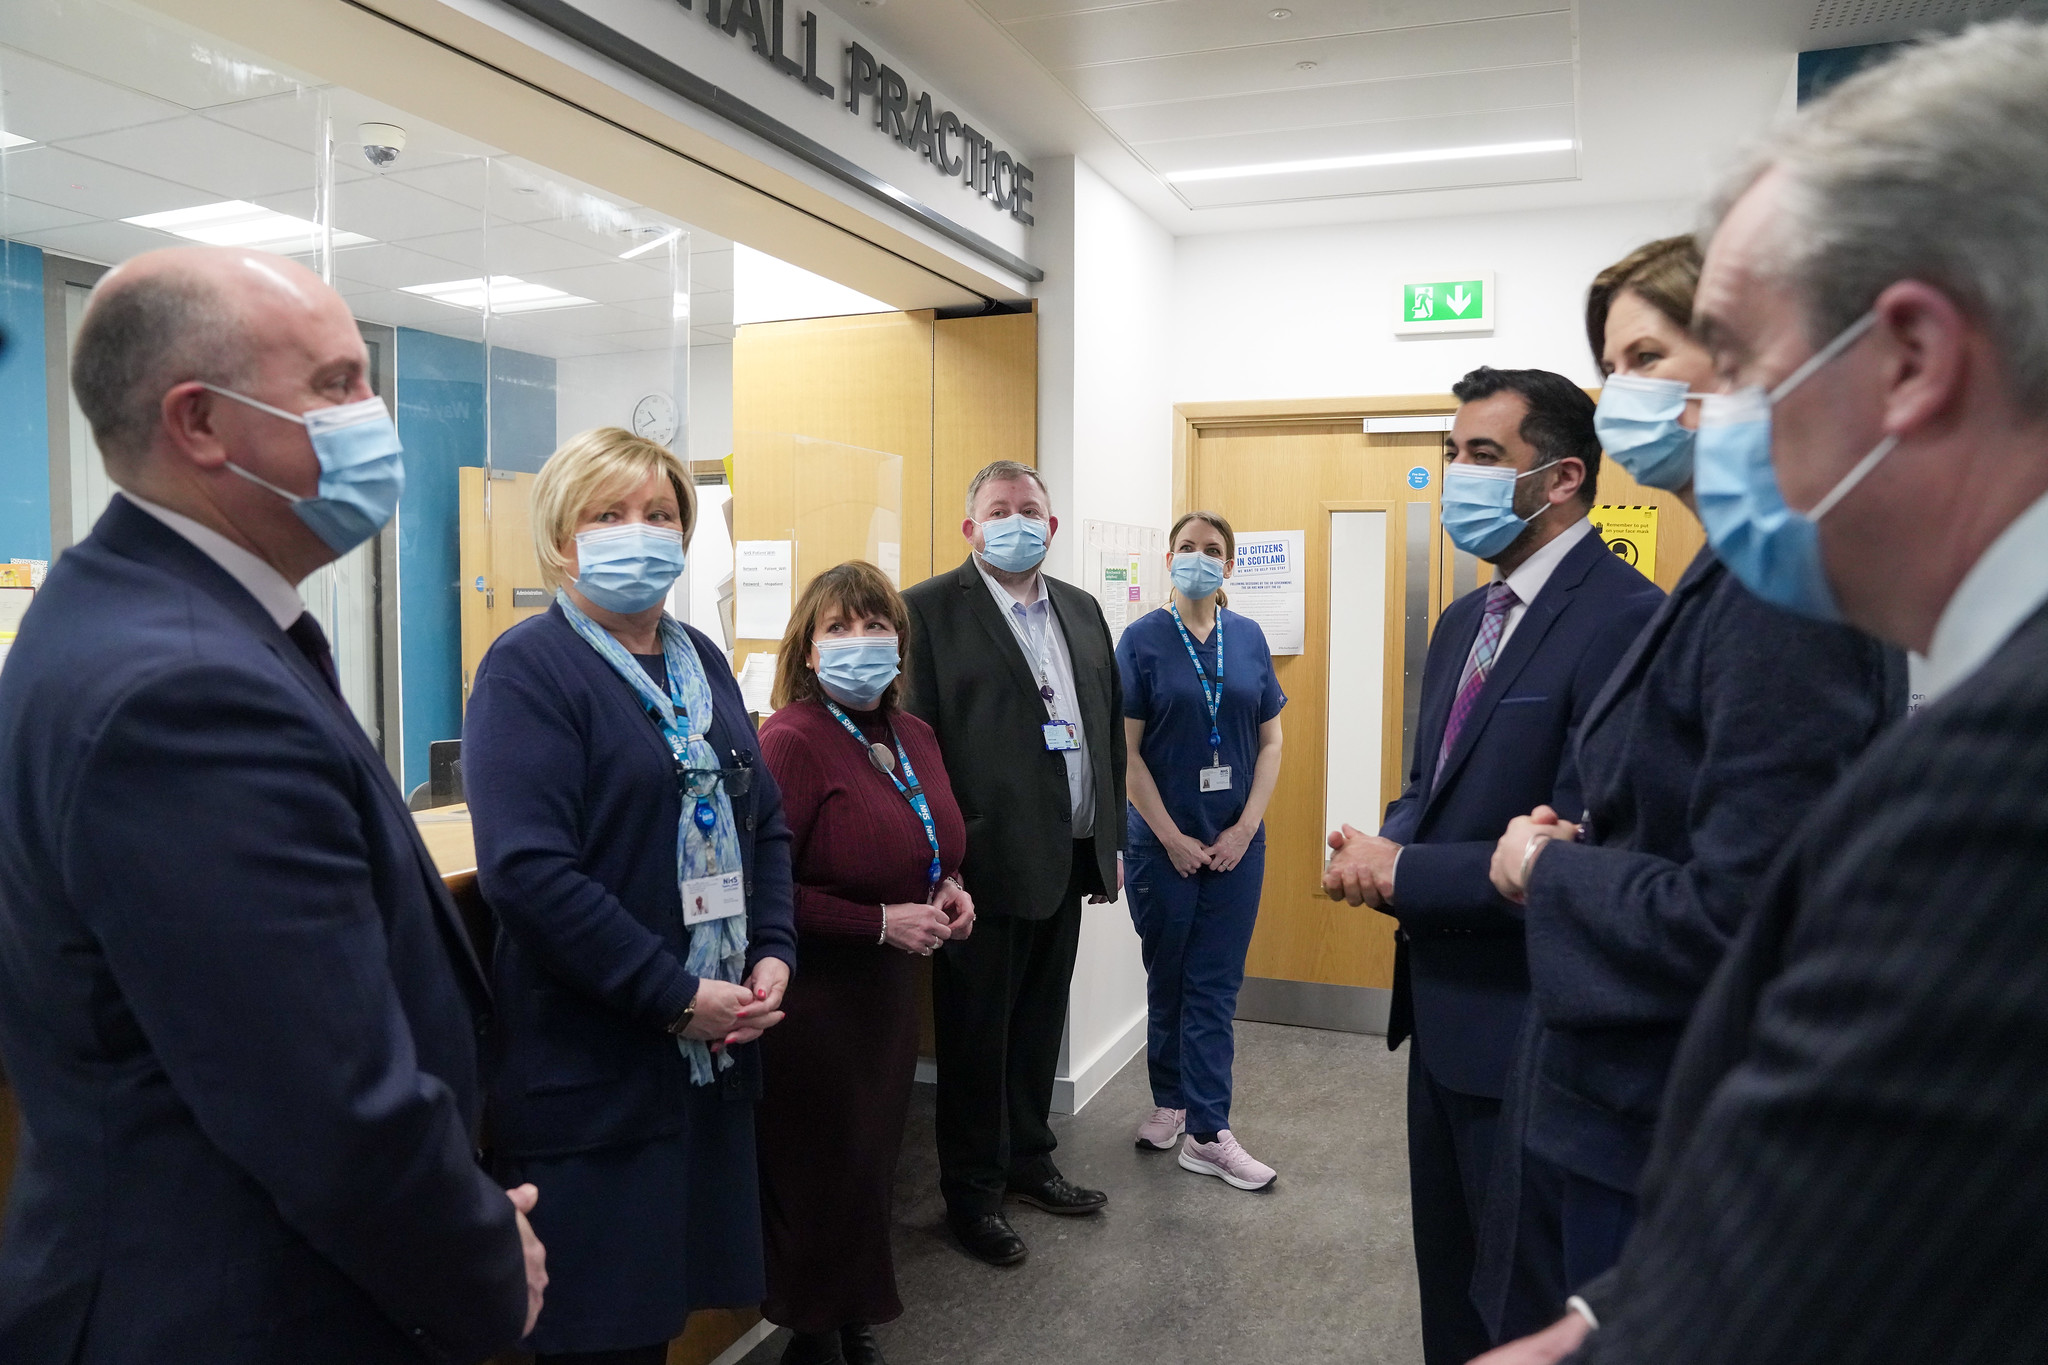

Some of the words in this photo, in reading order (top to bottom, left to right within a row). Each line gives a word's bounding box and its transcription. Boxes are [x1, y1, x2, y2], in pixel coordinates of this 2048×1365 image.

[677, 0, 834, 100] ALL
[849, 41, 1034, 227] PRACTICE
[1238, 547, 1247, 556] EU
[1250, 544, 1283, 555] CITIZENS
[1237, 557, 1245, 566] IN
[1247, 554, 1285, 566] SCOTLAND
[828, 702, 842, 717] NHS
[842, 718, 857, 734] NHS
[669, 734, 685, 754] NHS
[897, 744, 906, 759] NHS
[903, 762, 914, 777] NHS
[702, 813, 714, 822] NHS
[920, 804, 930, 821] NHS
[926, 825, 935, 841] NHS
[723, 876, 738, 885] NHS
